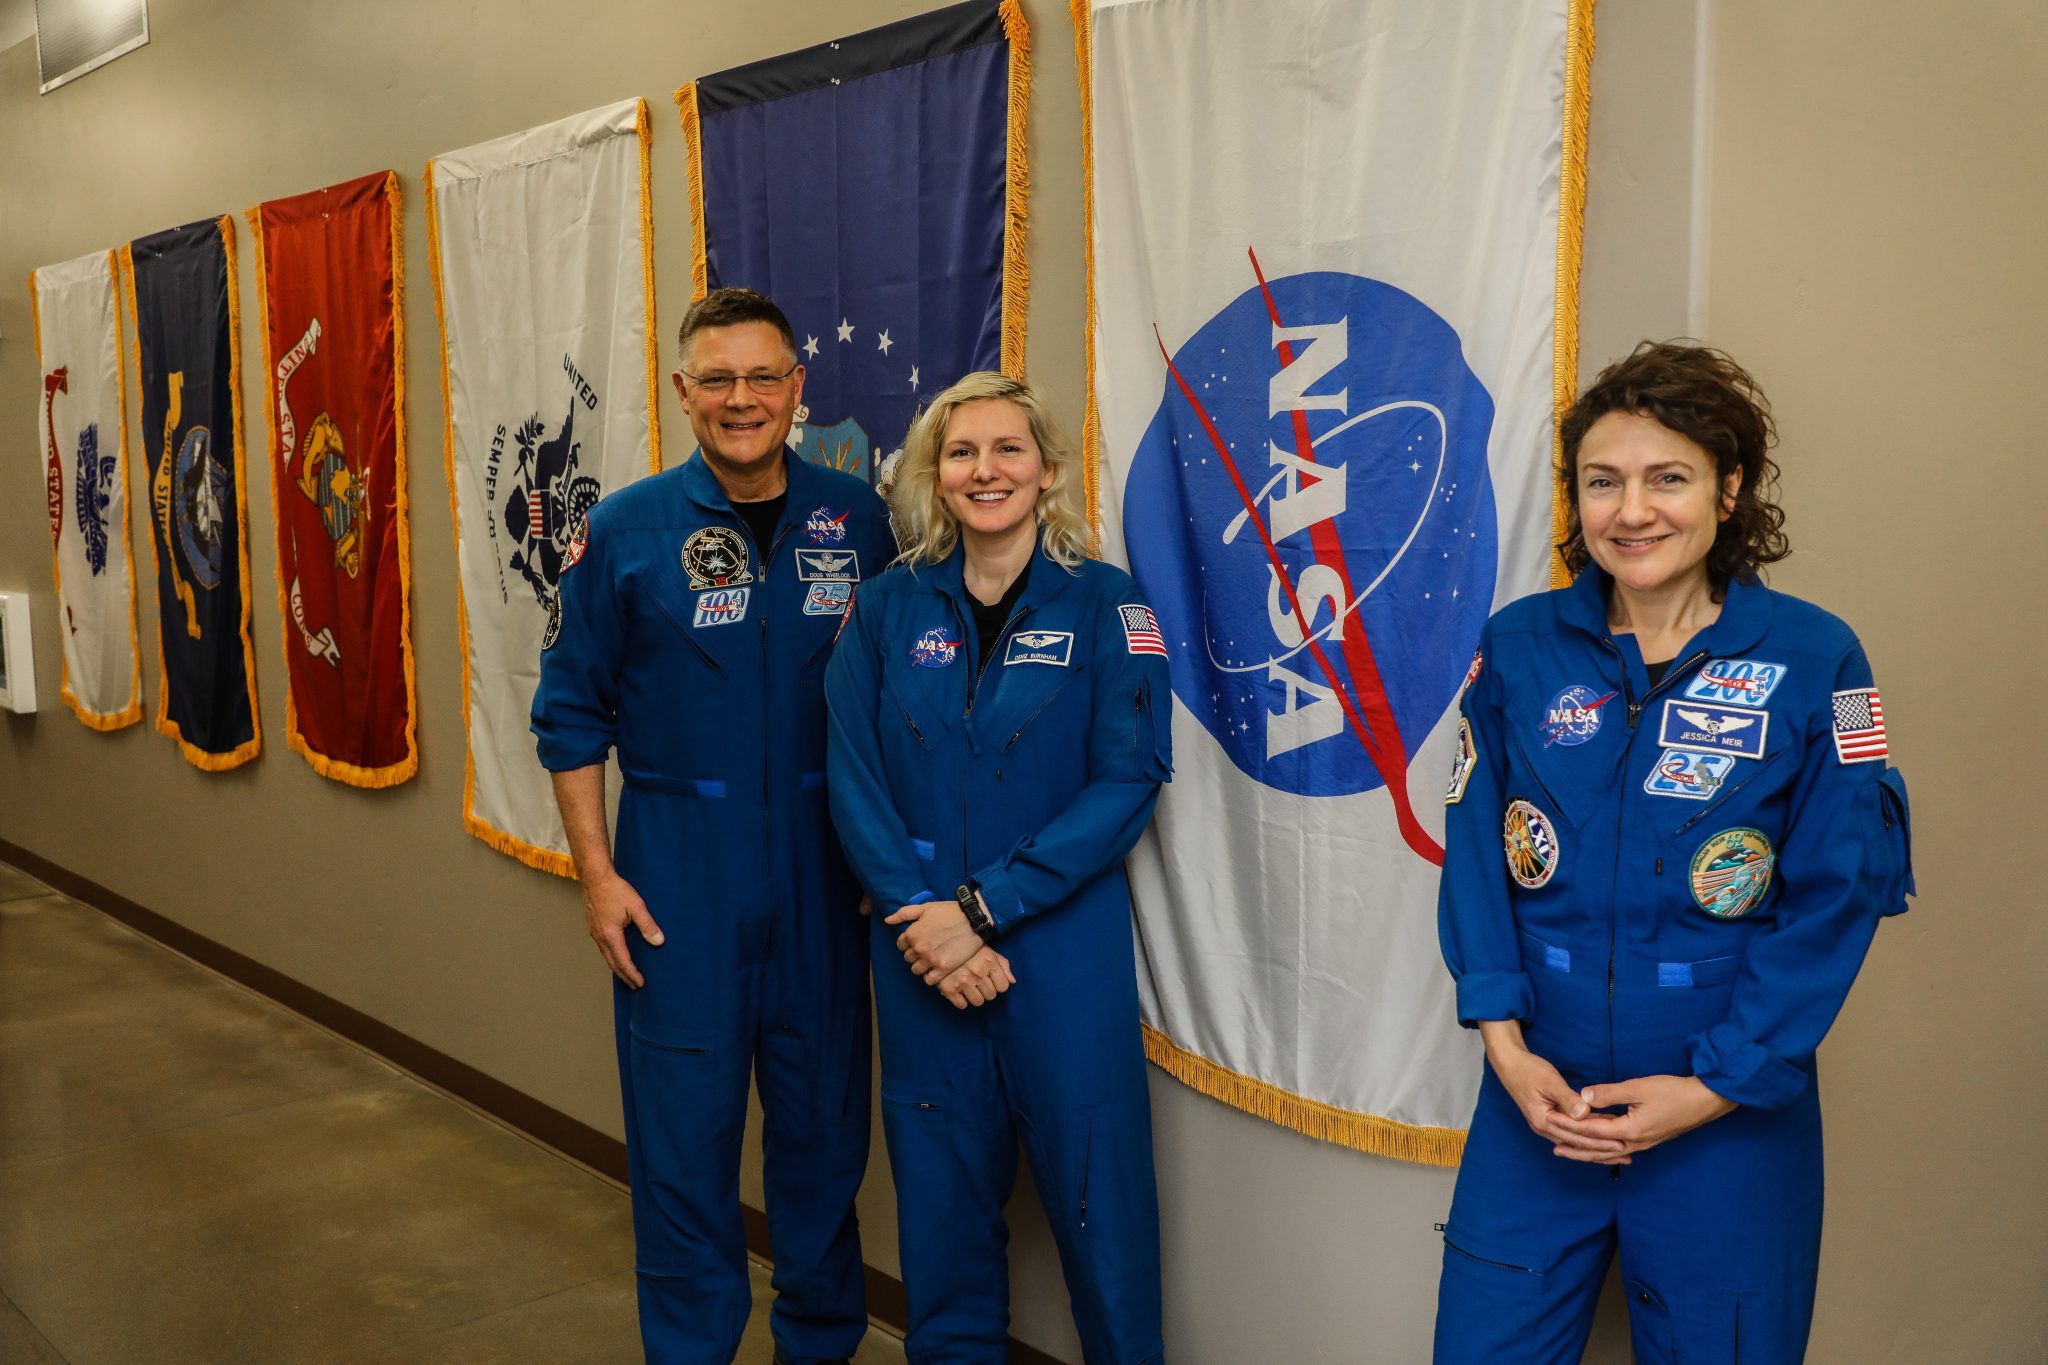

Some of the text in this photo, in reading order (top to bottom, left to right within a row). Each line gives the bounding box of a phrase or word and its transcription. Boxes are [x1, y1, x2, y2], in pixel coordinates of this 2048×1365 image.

[564, 353, 598, 411] UNITED
[807, 521, 845, 531] NASA
[1266, 315, 1348, 762] NASA
[698, 590, 746, 624] 100
[808, 586, 846, 611] 25
[917, 640, 955, 656] NASA
[1030, 653, 1058, 661] BURNHAM
[1694, 660, 1777, 703] 200
[1549, 709, 1600, 723] NASA
[1680, 732, 1744, 748] JESSICA MEIR
[1653, 753, 1721, 792] 25
[1527, 818, 1550, 854] LXI
[1725, 832, 1744, 849] 62
